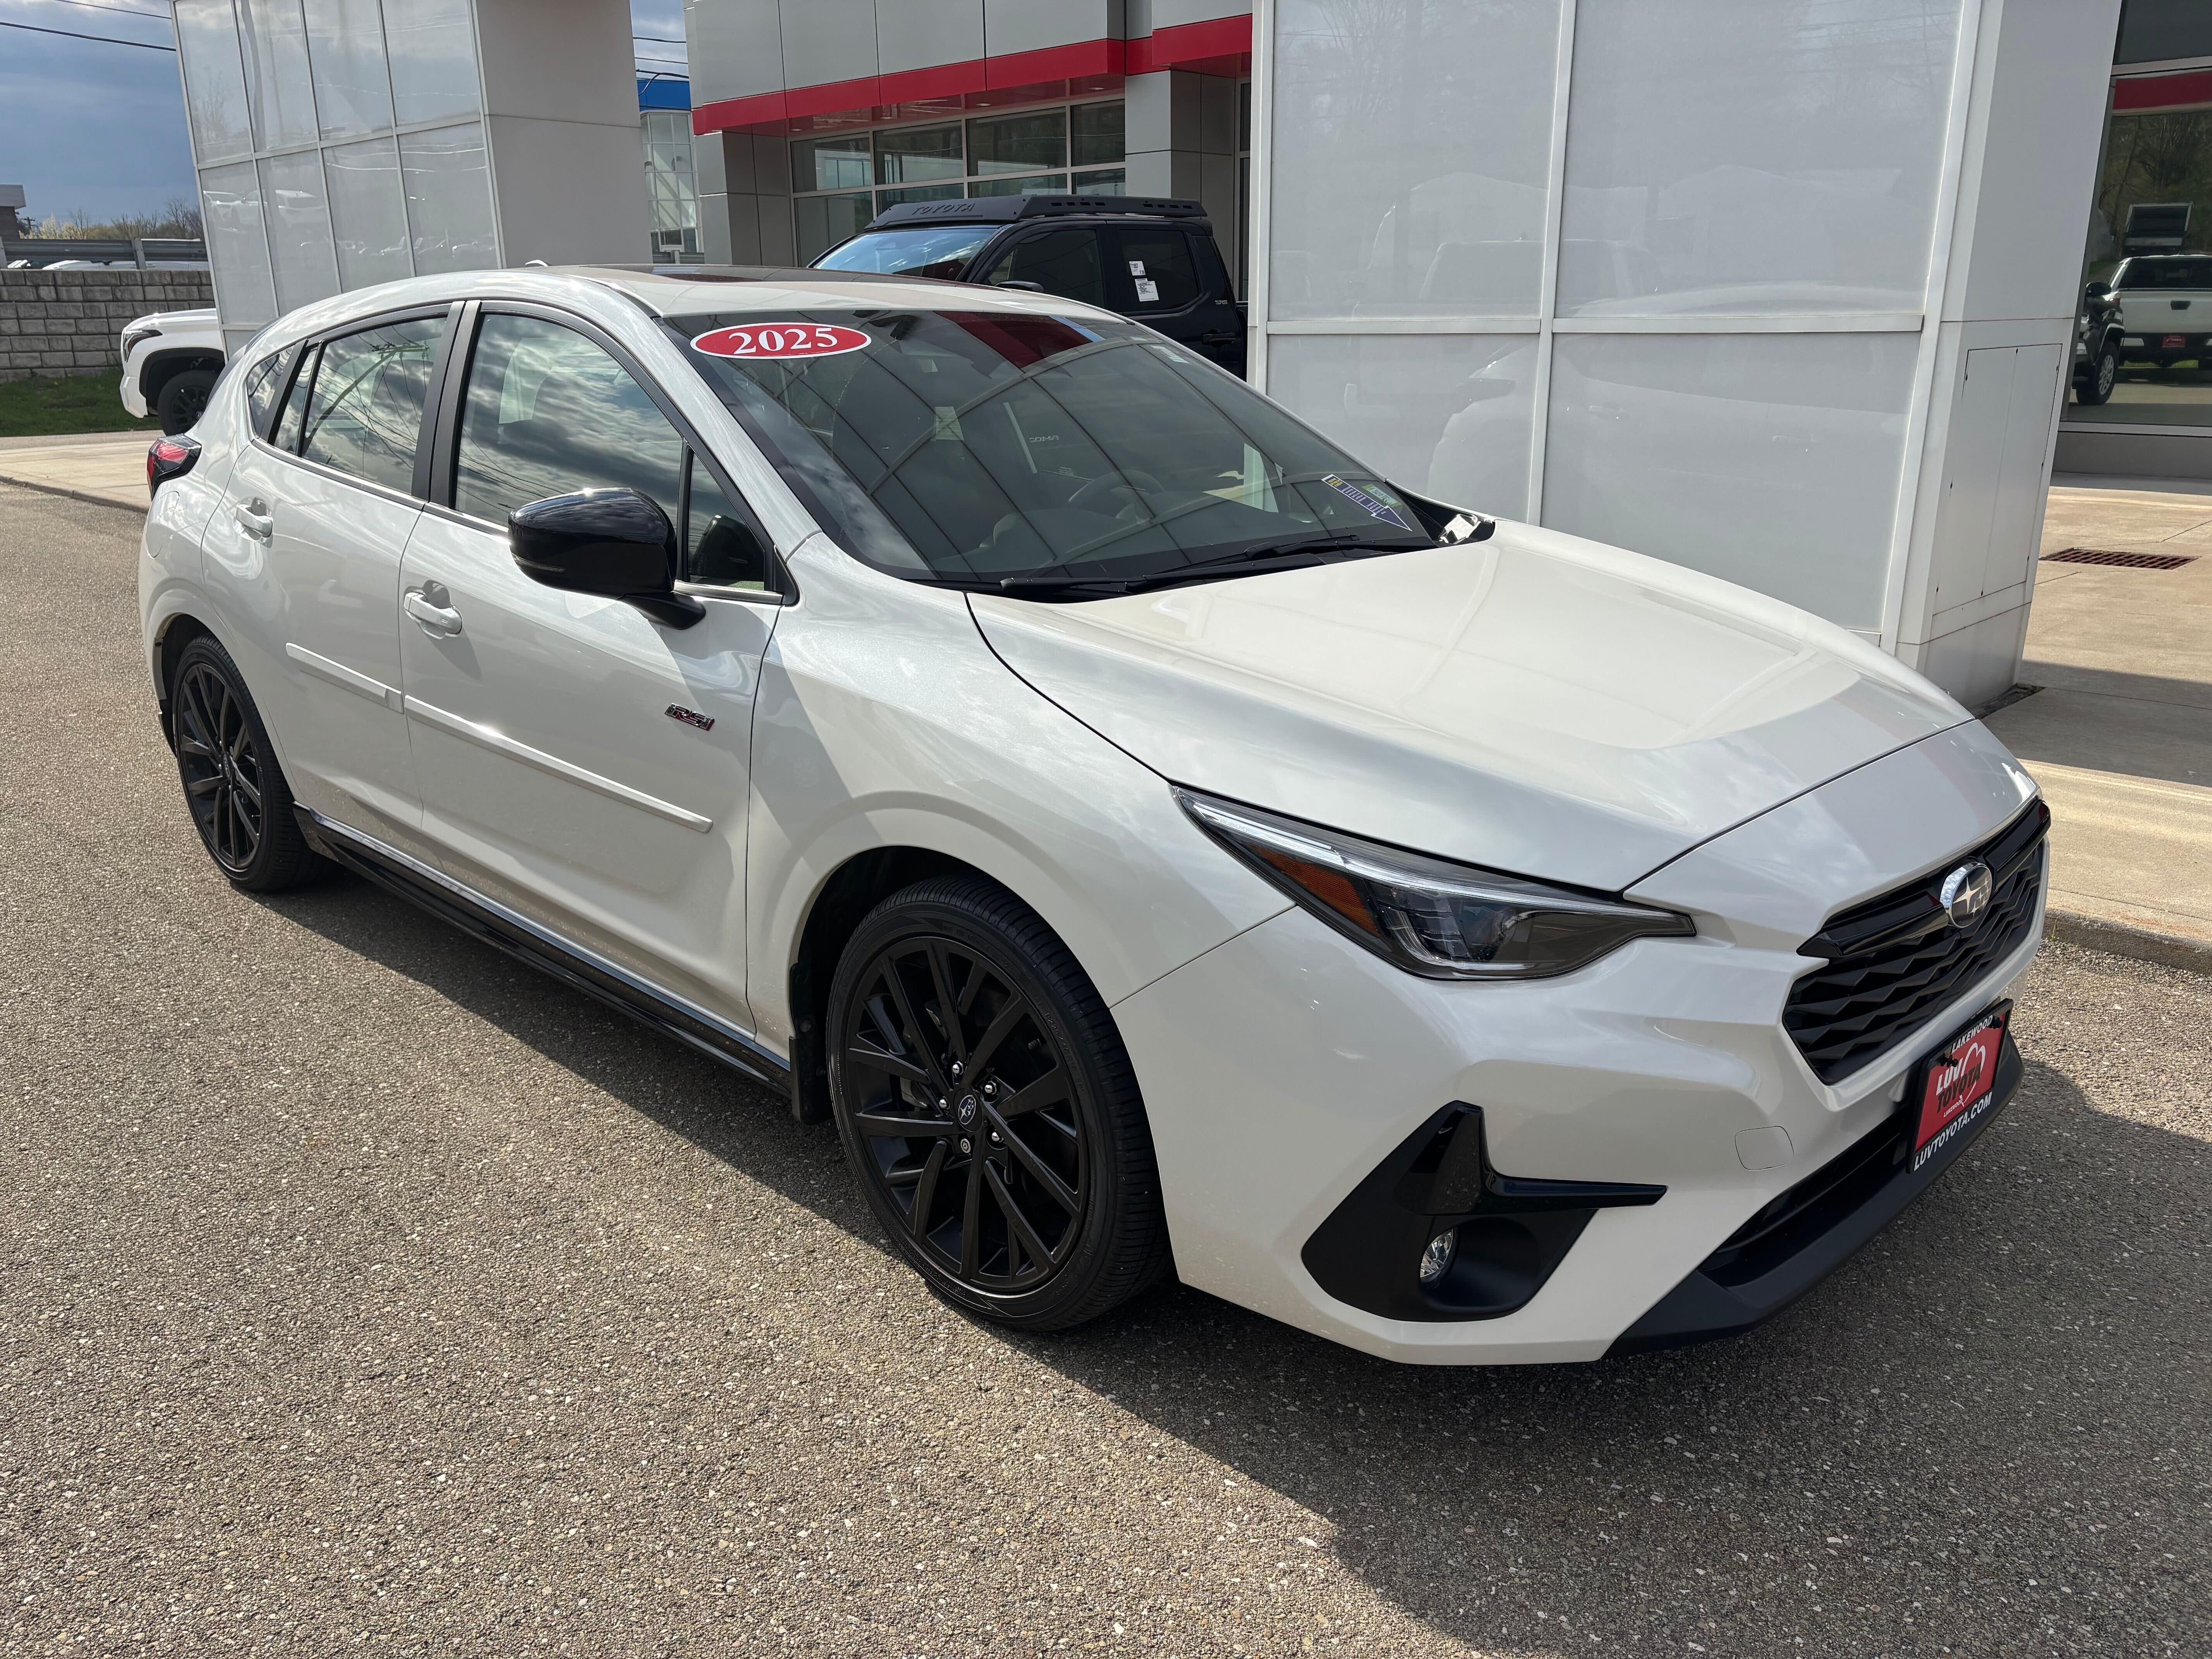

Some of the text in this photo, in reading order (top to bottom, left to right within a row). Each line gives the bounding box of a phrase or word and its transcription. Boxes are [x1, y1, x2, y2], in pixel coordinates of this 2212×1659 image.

[912, 203, 975, 215] TOYOTA
[728, 328, 838, 355] 2025
[669, 704, 709, 728] RS
[1219, 819, 1251, 833] SUBARU
[1951, 1015, 1993, 1054] LAKEWOOD
[1936, 1058, 1963, 1096] LUV
[1937, 1063, 1980, 1113] TOYOTA
[1914, 1091, 1992, 1172] LUVTOYOTA.COM
